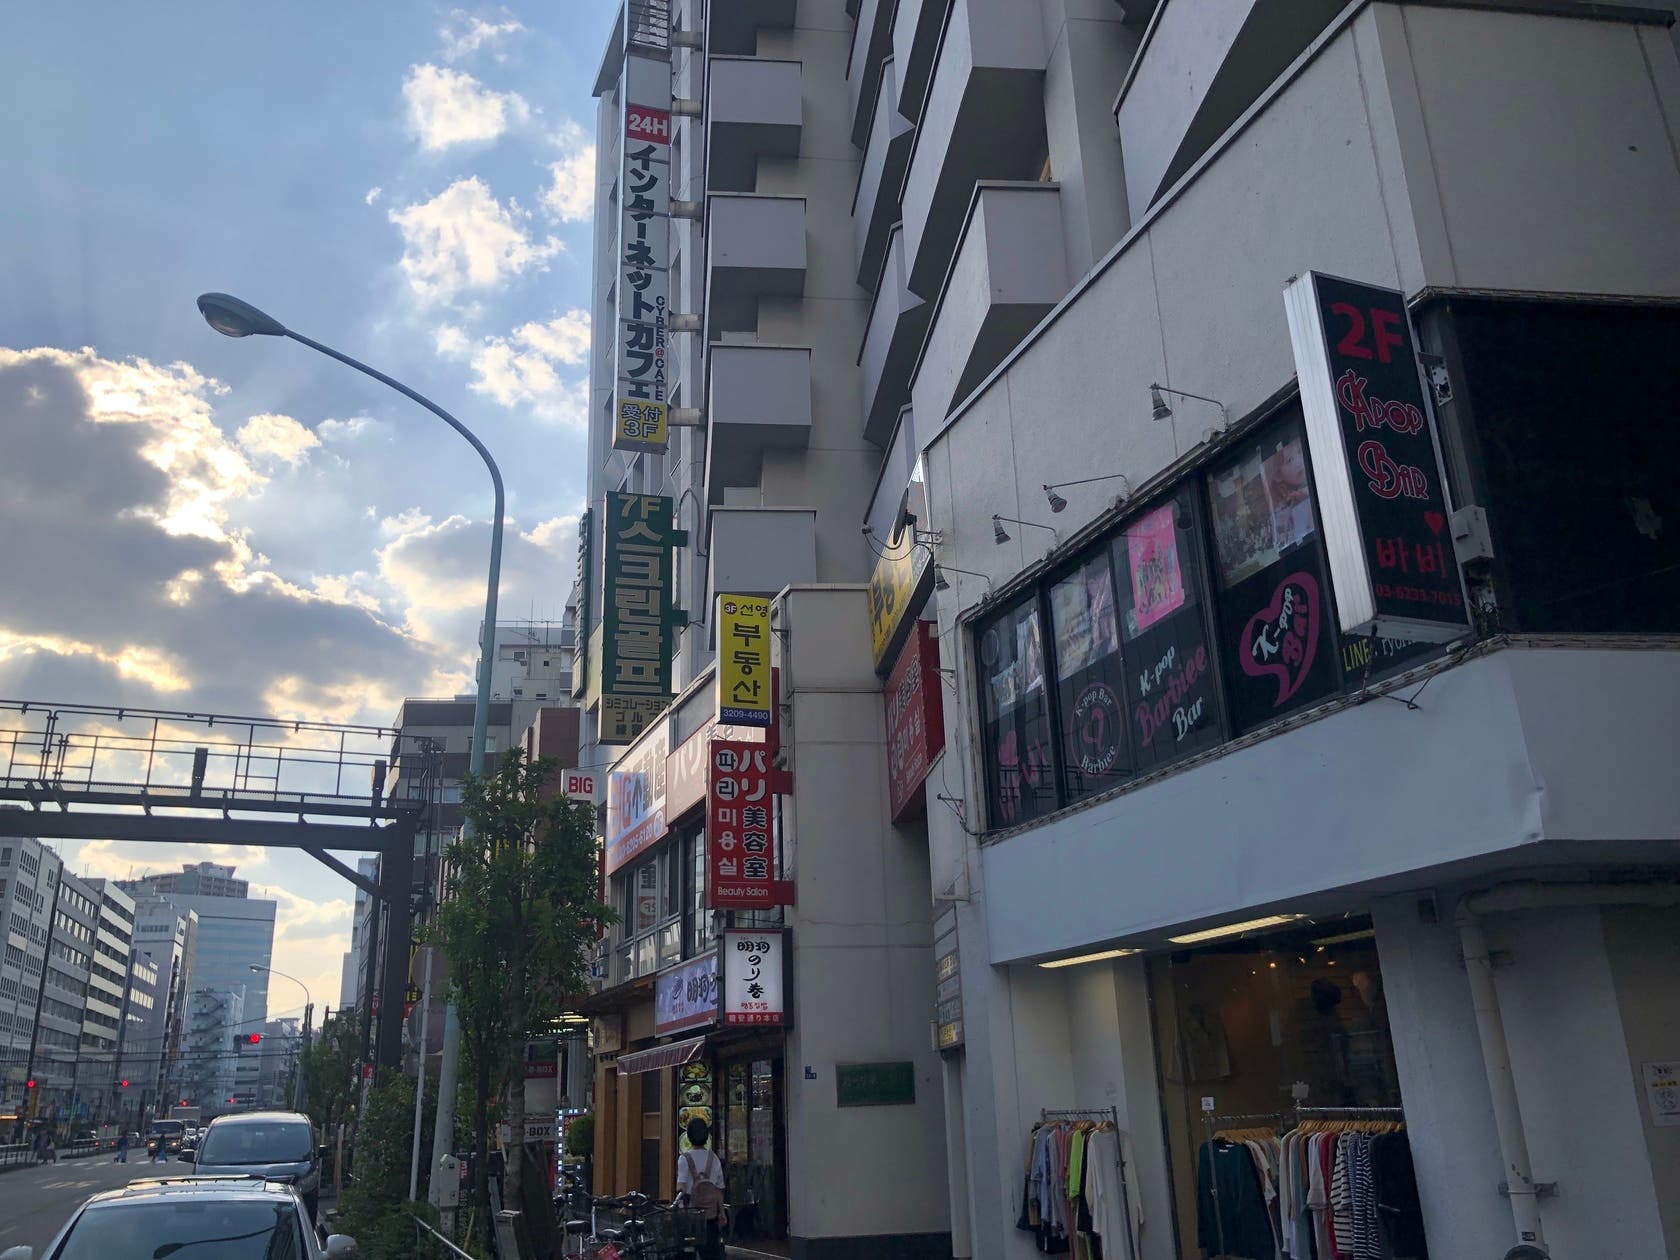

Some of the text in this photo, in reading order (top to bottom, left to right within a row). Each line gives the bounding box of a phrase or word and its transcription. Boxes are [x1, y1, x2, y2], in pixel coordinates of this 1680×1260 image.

[628, 113, 667, 137] 24H
[624, 145, 659, 399] インターネットカフェ
[1330, 302, 1404, 363] 2F
[621, 403, 662, 422] 受付
[624, 420, 658, 438] 3F
[617, 494, 662, 519] 7F
[1375, 536, 1447, 579] 바비
[613, 521, 664, 693] 스크린골프
[740, 603, 768, 617] 선영
[733, 622, 761, 704] 부동산
[1139, 645, 1176, 697] K-pop
[1342, 638, 1371, 672] LINE
[723, 708, 769, 721] 3209-4490
[1172, 696, 1204, 742] Bar
[568, 776, 593, 794] BIG
[738, 749, 768, 879] パリ美容室
[717, 886, 768, 897] Beauty Salon
